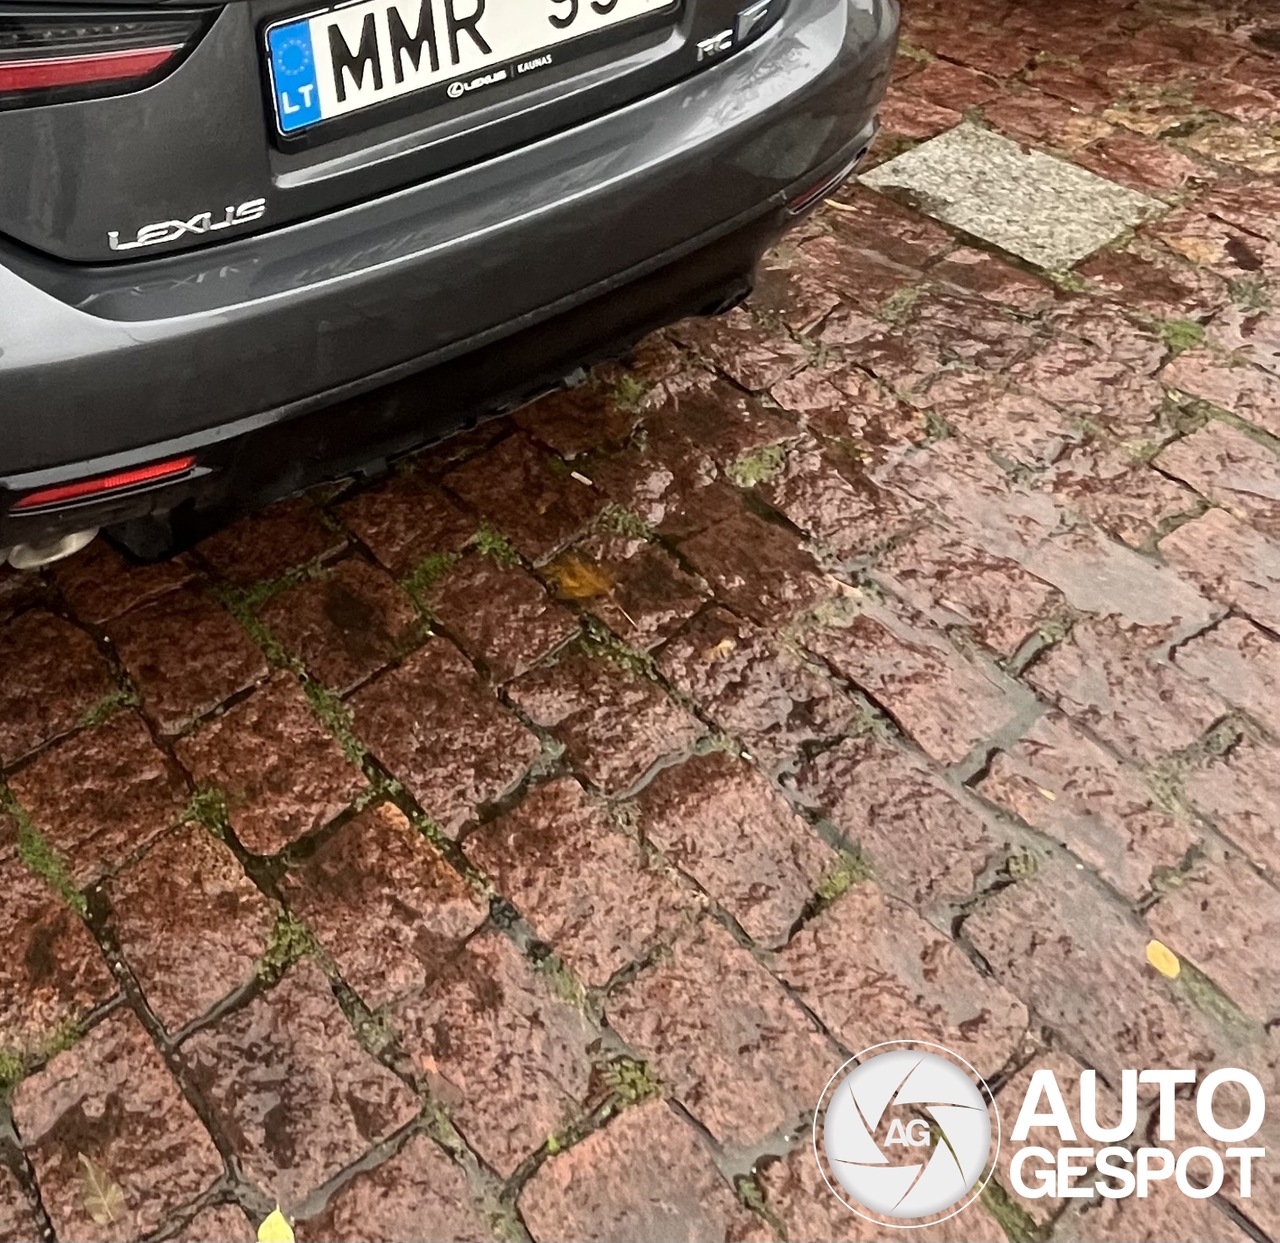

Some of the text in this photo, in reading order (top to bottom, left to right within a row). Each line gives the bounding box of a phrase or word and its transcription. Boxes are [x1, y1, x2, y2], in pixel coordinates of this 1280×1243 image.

[464, 70, 507, 91] LEXUS
[517, 54, 552, 74] KAUNAS
[281, 84, 314, 114] LT
[107, 198, 266, 250] LEXUS
